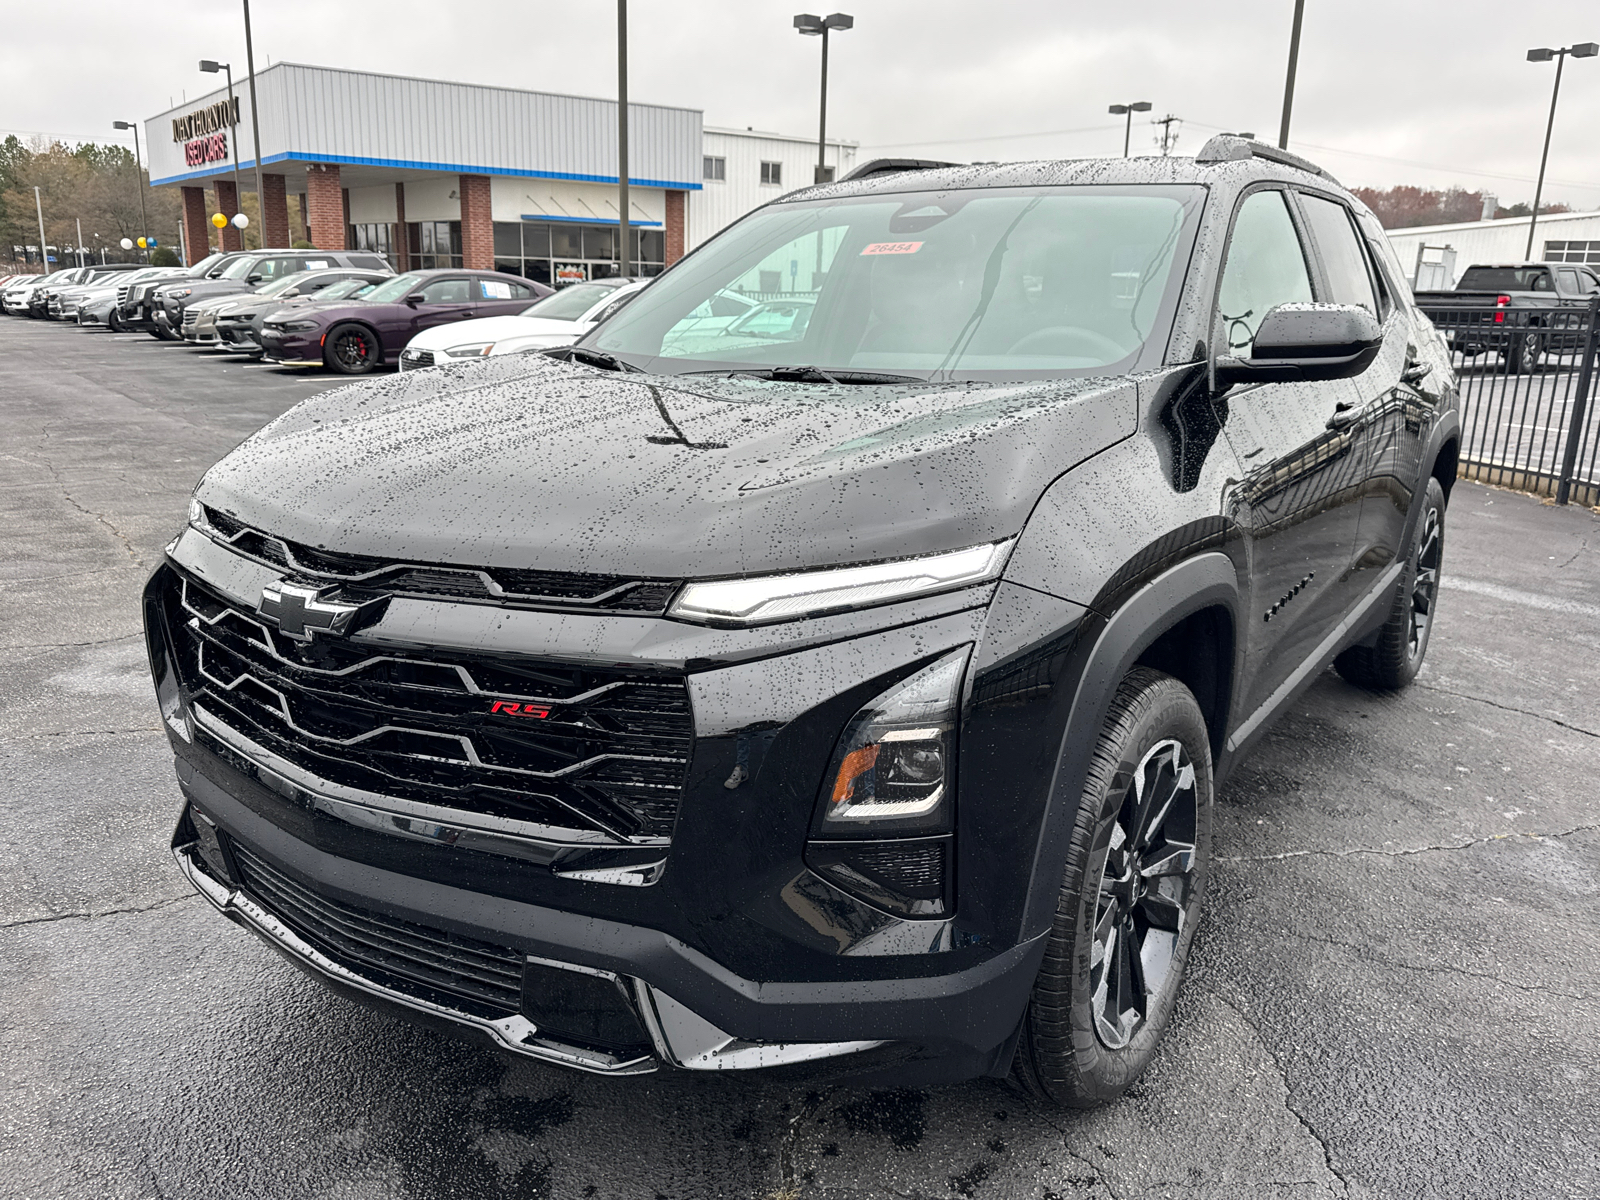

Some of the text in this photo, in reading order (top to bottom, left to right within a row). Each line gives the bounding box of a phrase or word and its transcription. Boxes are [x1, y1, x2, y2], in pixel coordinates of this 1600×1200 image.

[171, 96, 240, 143] JOHN THORNTON
[184, 133, 228, 168] USED CARS
[869, 243, 913, 253] 26454
[490, 700, 553, 719] RS
